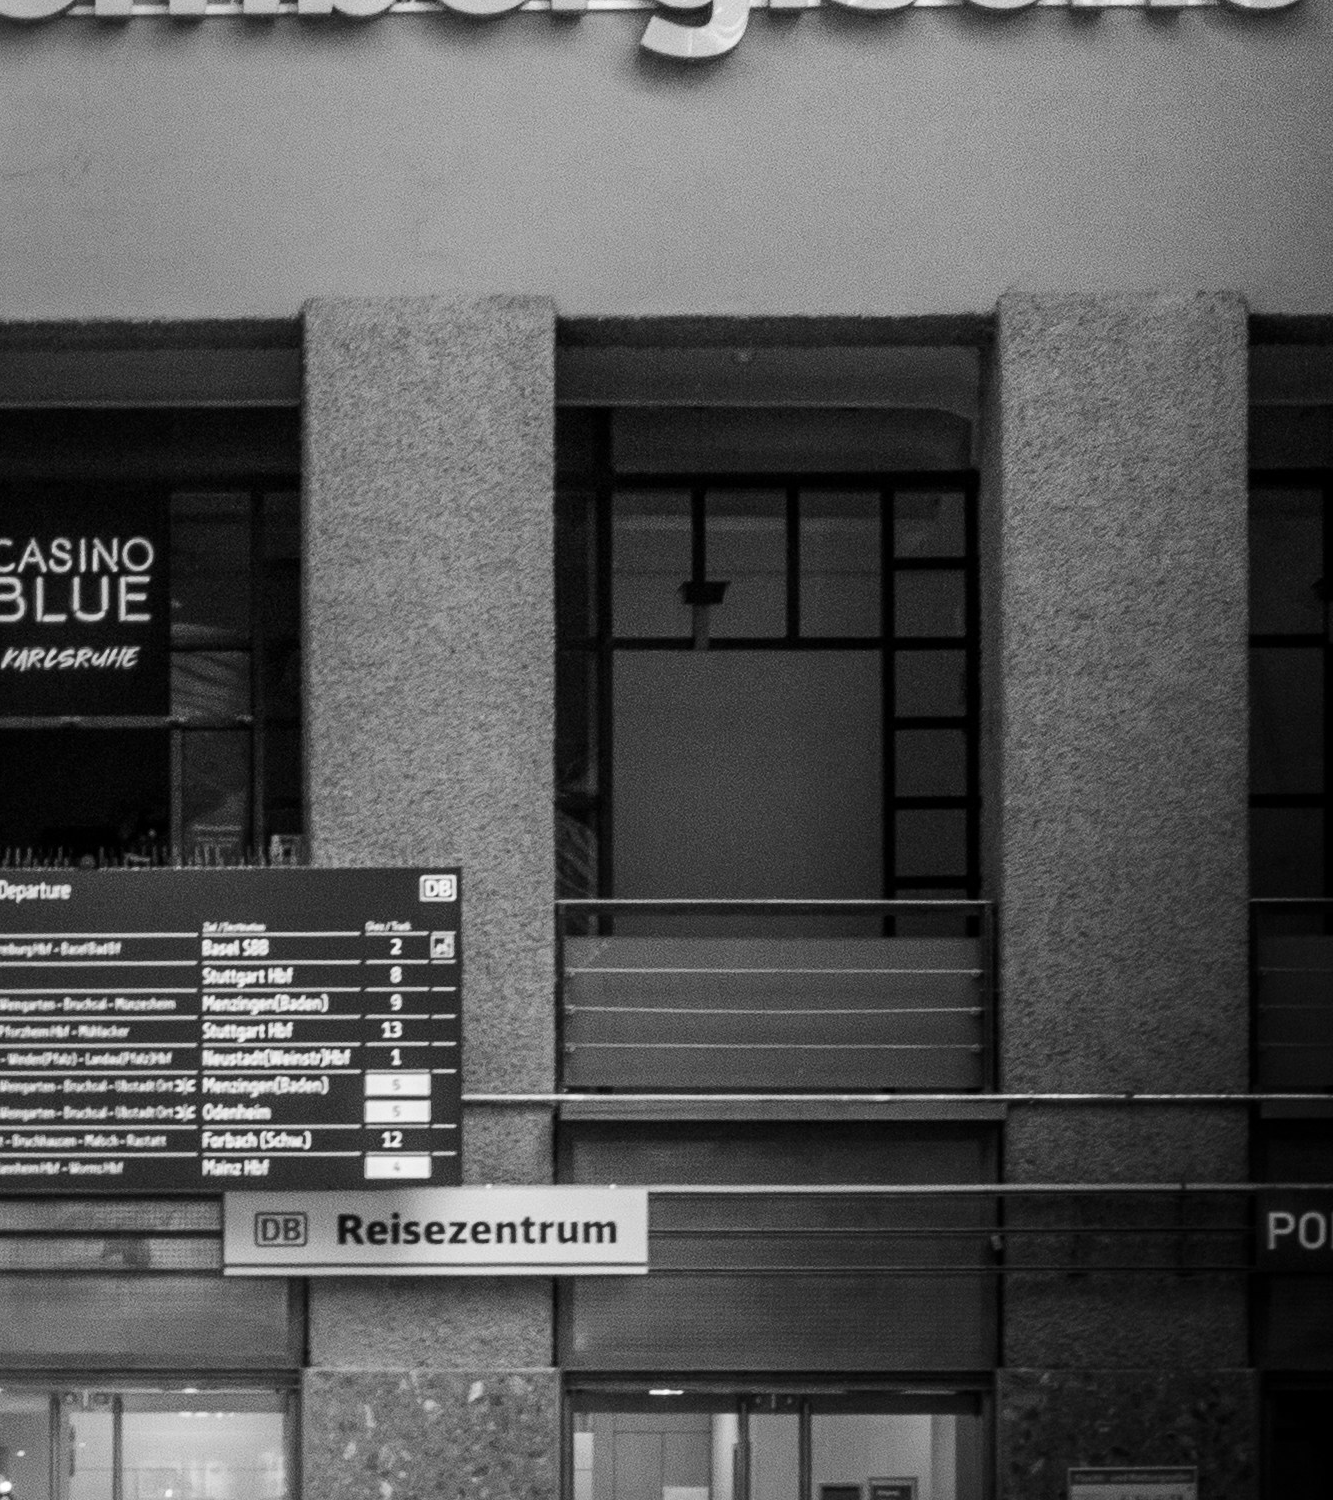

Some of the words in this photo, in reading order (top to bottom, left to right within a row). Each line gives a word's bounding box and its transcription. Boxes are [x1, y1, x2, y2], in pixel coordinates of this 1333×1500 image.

[0, 646, 141, 672] KARLSRUHE
[202, 939, 240, 956] Basel
[242, 938, 269, 956] SBB
[390, 938, 402, 955] 2
[202, 966, 265, 988] Stuttgart
[267, 966, 293, 984] Hbf
[390, 966, 402, 983] 8
[202, 993, 329, 1015] Menzingen(Baden)
[390, 994, 402, 1011] 9
[202, 1021, 265, 1042] Stuttgart
[268, 1021, 293, 1039] Hbf
[381, 1021, 402, 1038] 13
[391, 1049, 402, 1066] 1
[202, 1074, 329, 1098] Menzingen(Baden)
[392, 1079, 401, 1091] 5
[202, 1103, 272, 1121] Odenheim
[392, 1106, 401, 1118] 5
[202, 1129, 258, 1148] Forbach
[381, 1131, 402, 1148] 12
[202, 1159, 242, 1176] Mainz
[244, 1159, 270, 1176] Hbf
[261, 1218, 302, 1241] DB
[336, 1212, 619, 1246] Reisezentrum
[1267, 1211, 1333, 1251] PO
